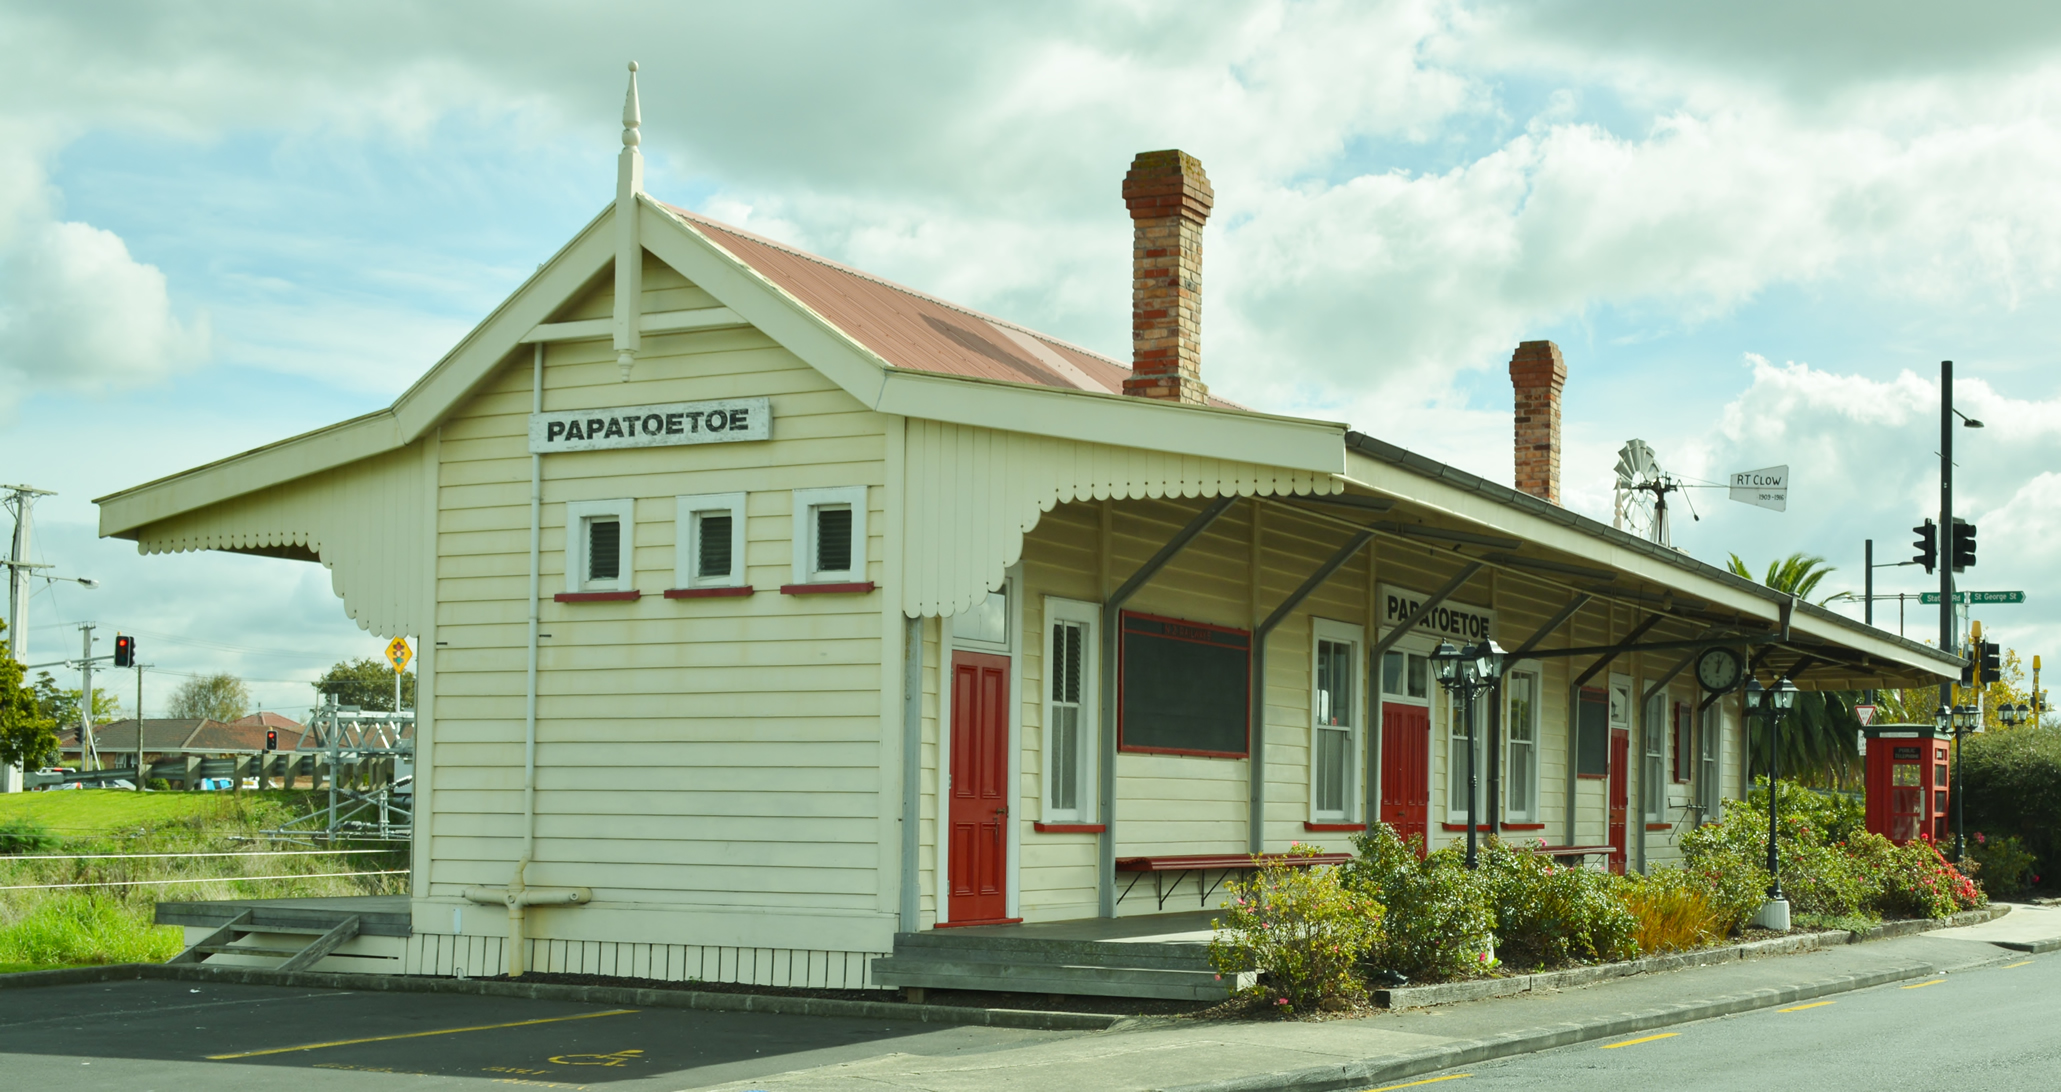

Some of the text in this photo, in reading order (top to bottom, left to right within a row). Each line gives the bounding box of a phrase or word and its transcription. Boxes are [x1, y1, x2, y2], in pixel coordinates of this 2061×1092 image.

[547, 408, 749, 442] PAPATOETOE
[1753, 474, 1782, 486] CLOW
[1927, 594, 1961, 602] Stat Rd
[1984, 593, 2007, 602] George
[2009, 592, 2017, 600] St
